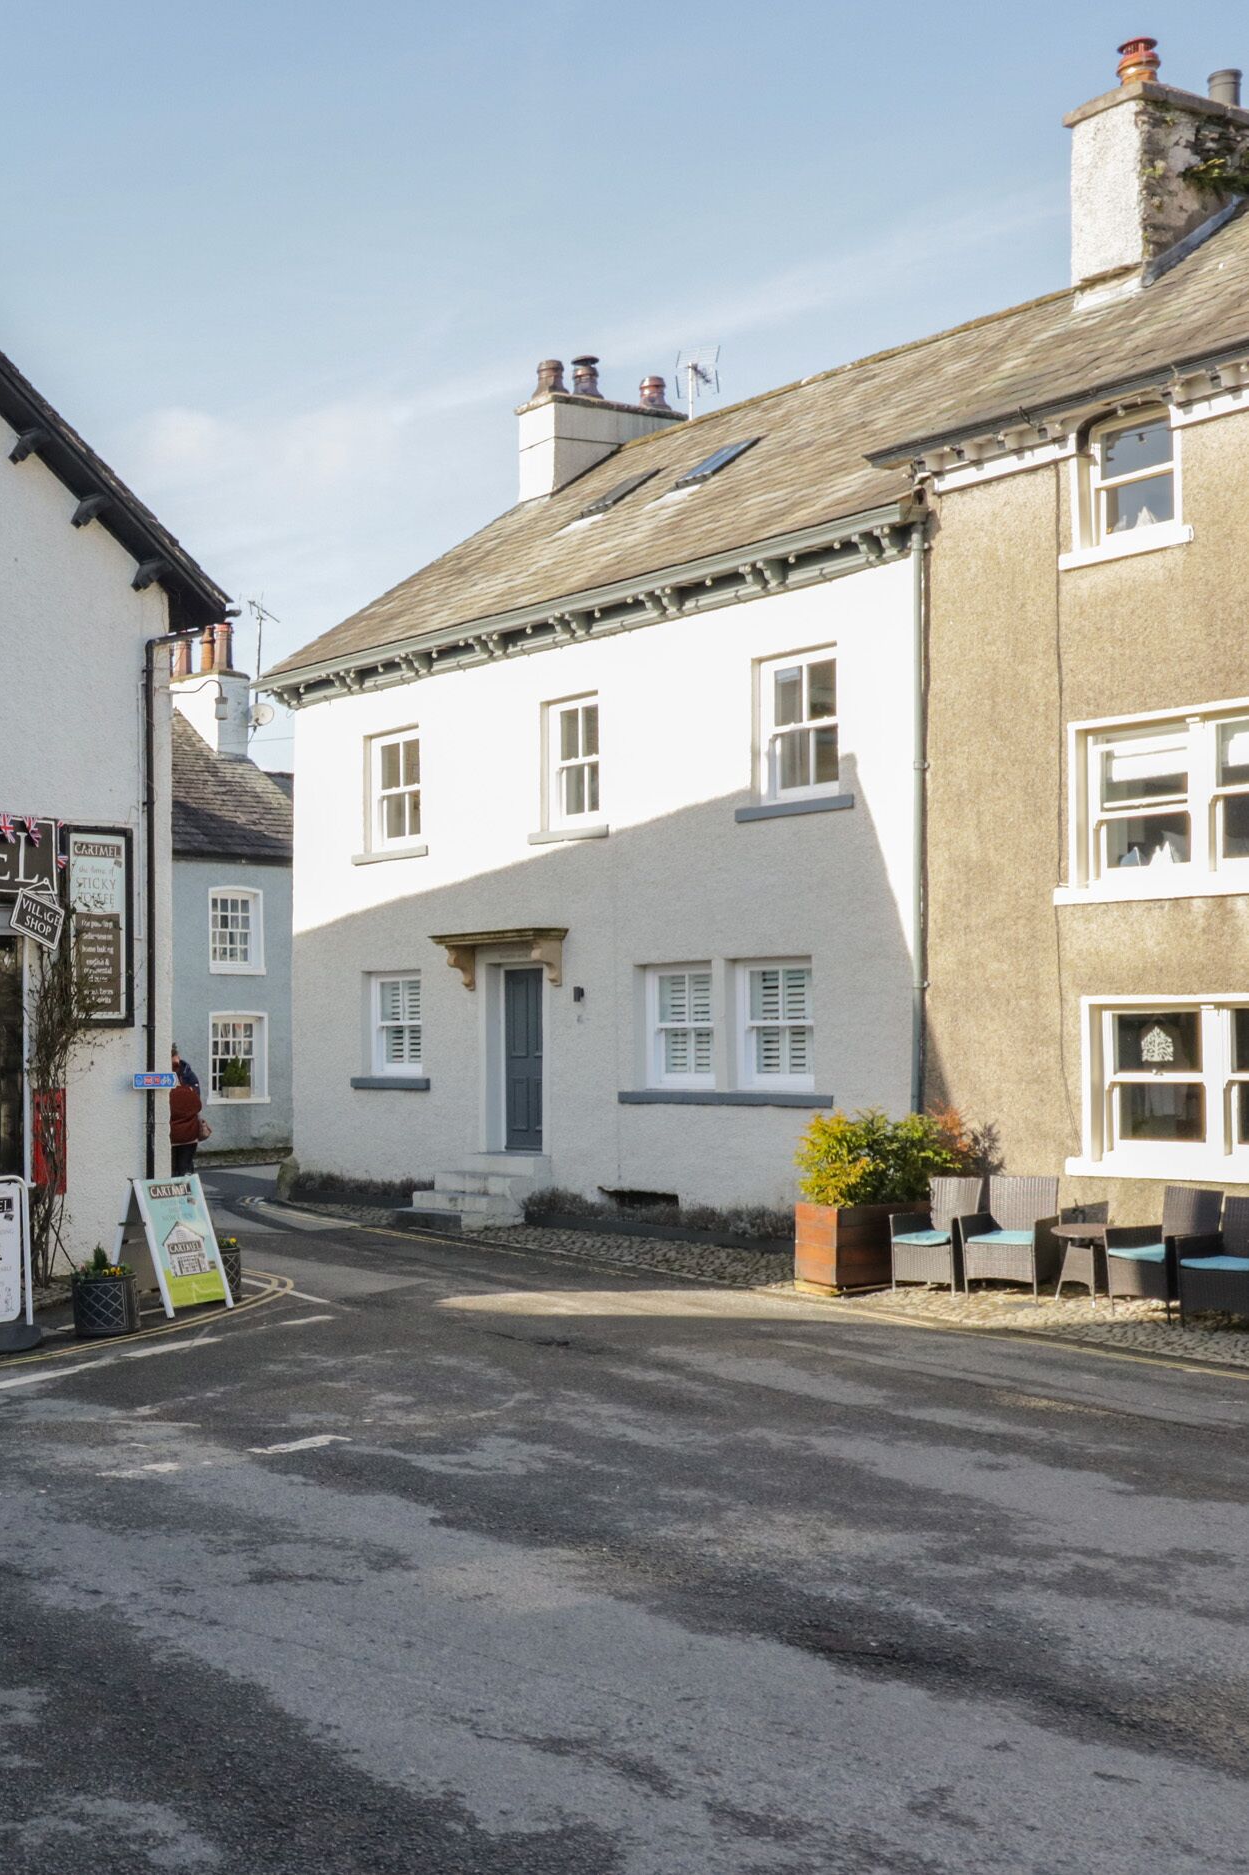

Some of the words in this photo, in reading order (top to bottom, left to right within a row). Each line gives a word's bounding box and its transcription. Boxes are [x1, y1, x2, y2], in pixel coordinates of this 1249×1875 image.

[74, 843, 120, 857] CARTMEL
[76, 877, 116, 890] STICKY
[24, 915, 52, 936] SHOP
